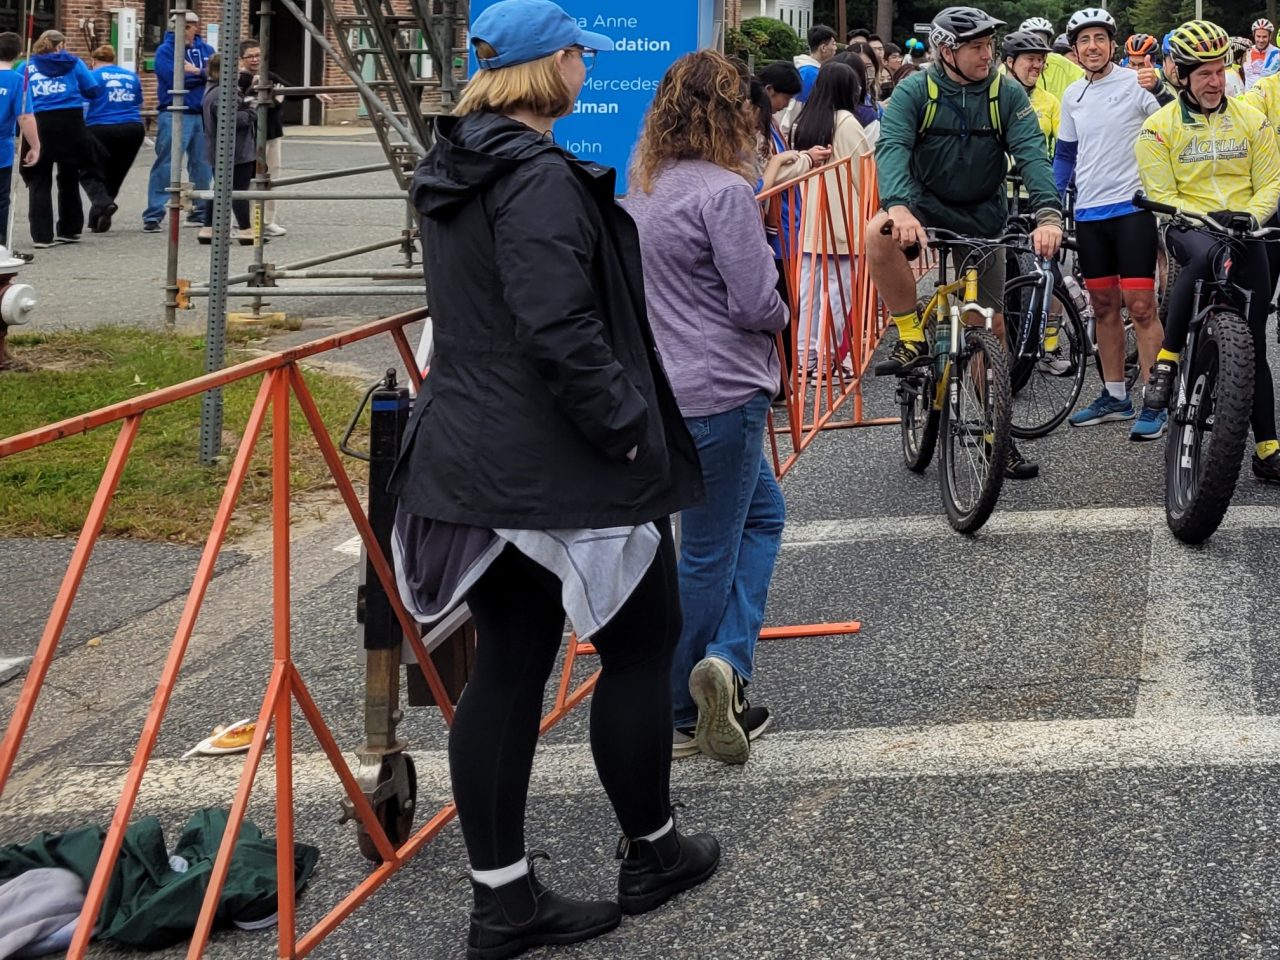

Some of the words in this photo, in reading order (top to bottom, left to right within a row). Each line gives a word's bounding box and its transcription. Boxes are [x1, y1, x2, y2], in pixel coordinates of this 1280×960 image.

[592, 14, 638, 28] Anne
[612, 37, 671, 51] dation
[573, 100, 619, 114] dman
[1179, 135, 1248, 155] ACELLA
